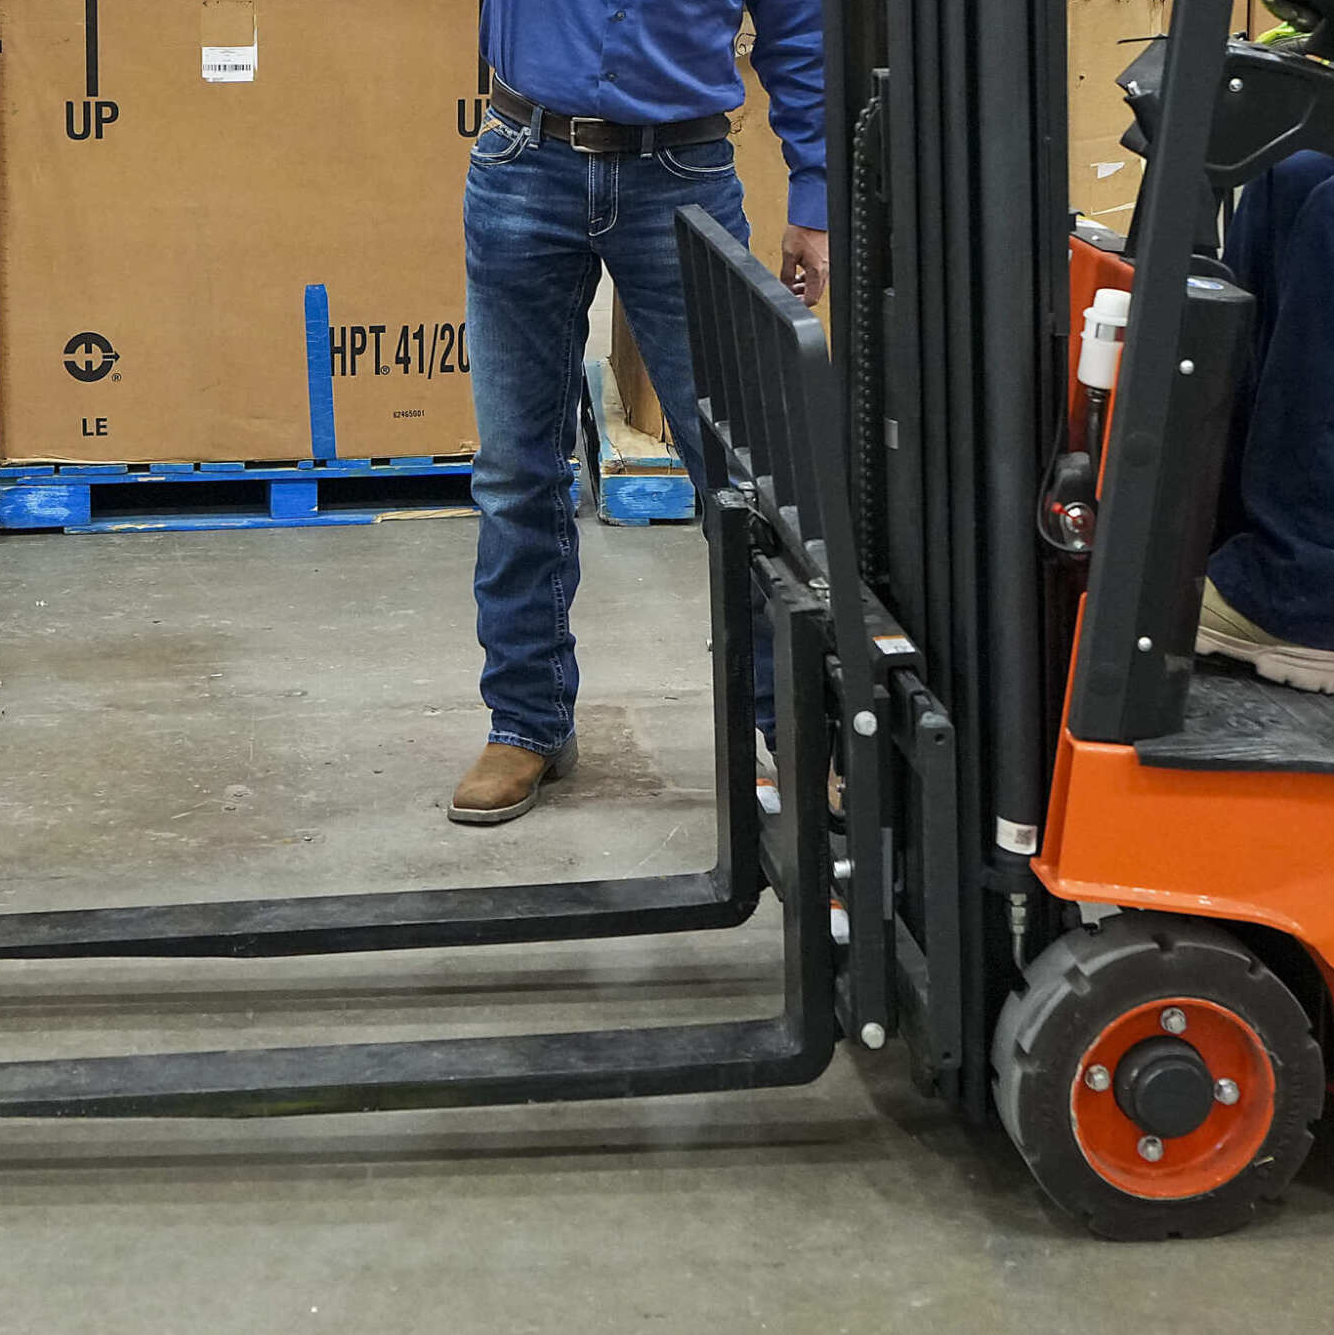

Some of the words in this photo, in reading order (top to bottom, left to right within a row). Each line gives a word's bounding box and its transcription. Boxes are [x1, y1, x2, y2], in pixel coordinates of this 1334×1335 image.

[65, 101, 119, 141] UP
[457, 99, 491, 138] U
[82, 417, 108, 436] LE
